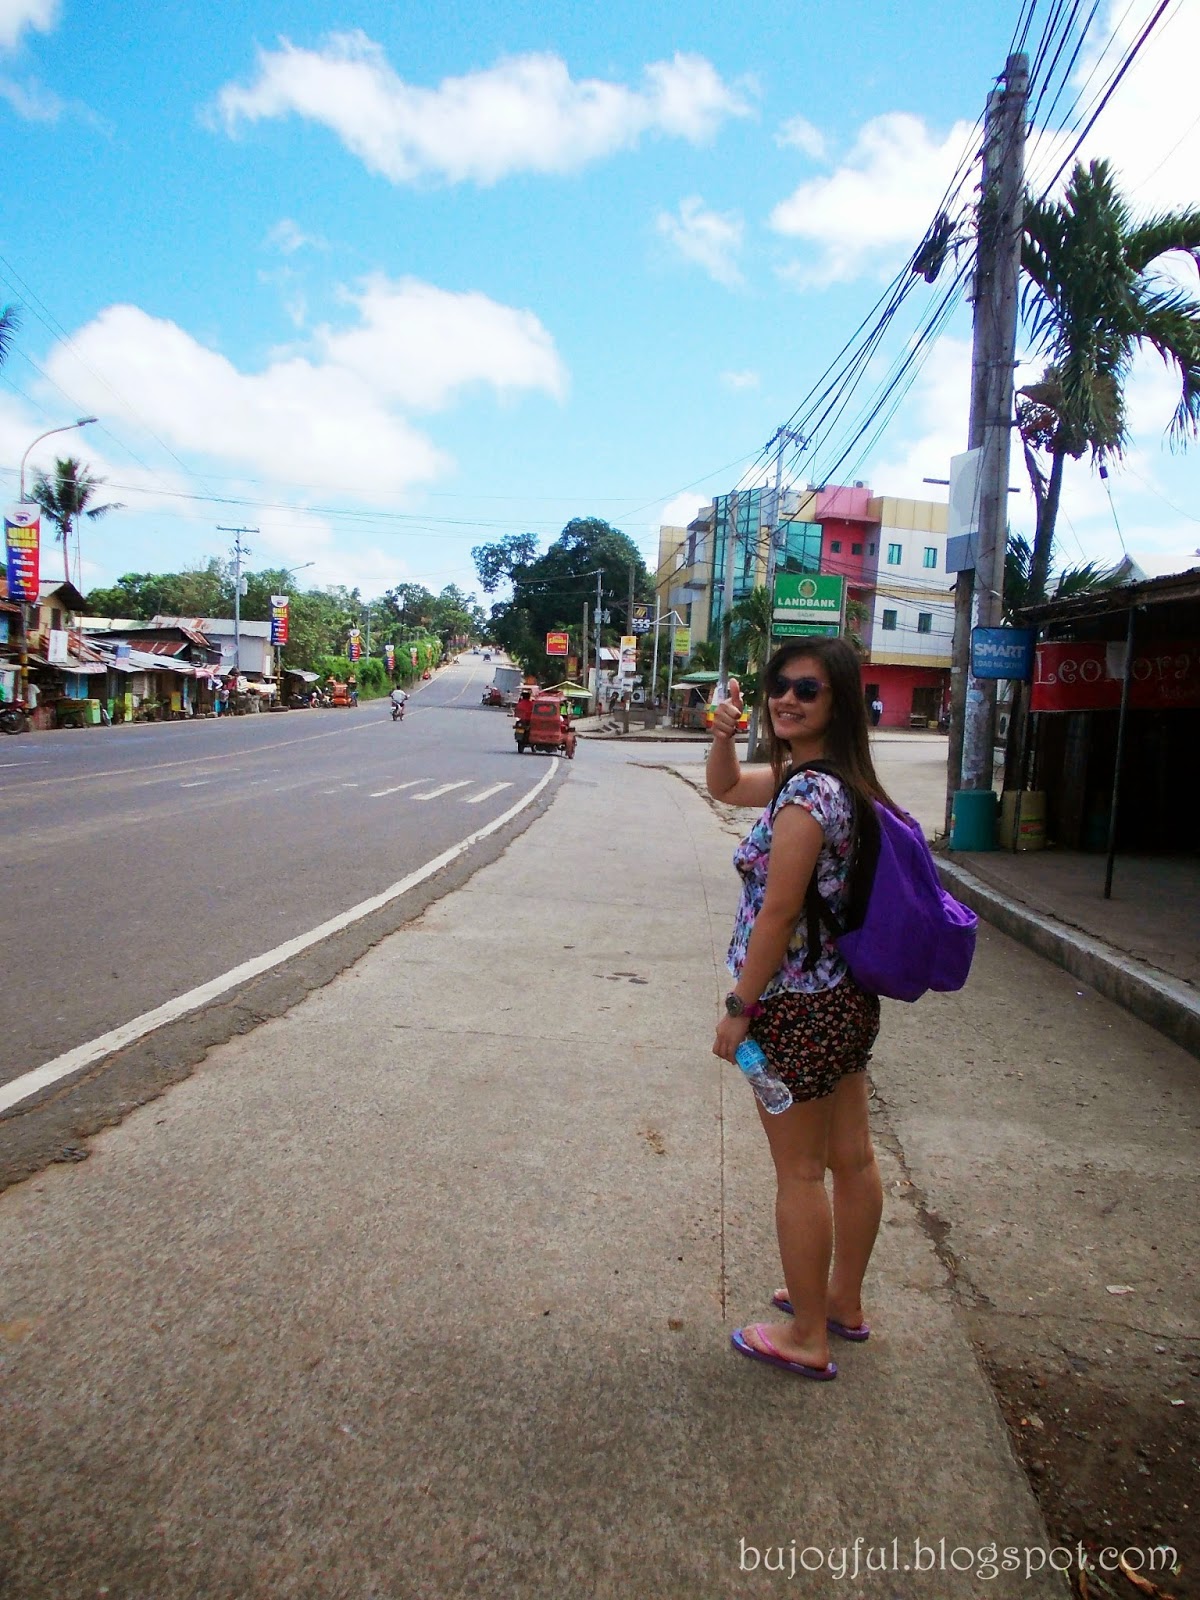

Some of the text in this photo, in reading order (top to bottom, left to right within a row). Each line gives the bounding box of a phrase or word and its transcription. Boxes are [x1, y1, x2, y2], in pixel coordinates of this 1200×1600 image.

[777, 597, 836, 608] LANDBANK
[974, 642, 1026, 658] SMART
[974, 660, 992, 668] LOAD
